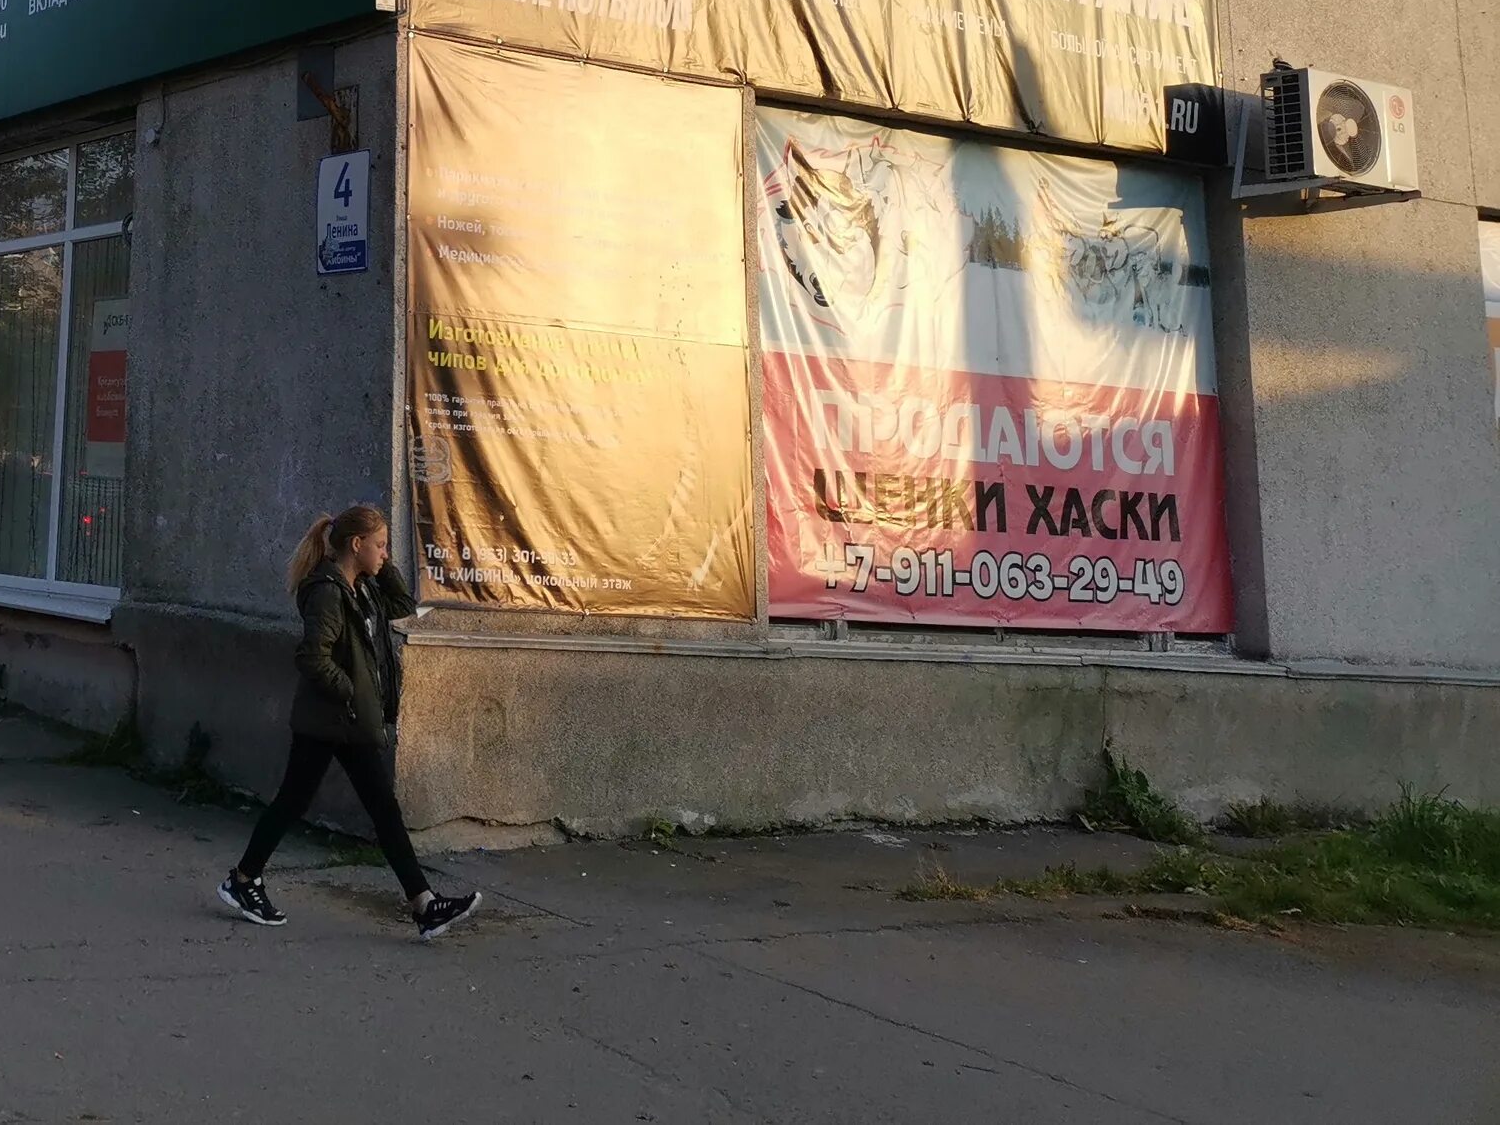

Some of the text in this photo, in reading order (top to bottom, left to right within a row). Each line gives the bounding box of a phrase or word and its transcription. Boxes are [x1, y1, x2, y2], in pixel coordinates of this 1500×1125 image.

[334, 161, 353, 208] 4
[326, 223, 359, 239] Ленина
[427, 350, 487, 372] чипов
[814, 389, 1175, 476] ПРОДАЮТСЯ
[814, 468, 1181, 542] ЩЕНКИ ХАСКИ
[425, 543, 452, 560] Тел.
[462, 547, 470, 561] 8
[425, 566, 445, 585] ТЦ
[526, 572, 598, 589] цокольный
[601, 578, 633, 590] этаж
[814, 542, 1184, 606] +7-911-063-29-49
